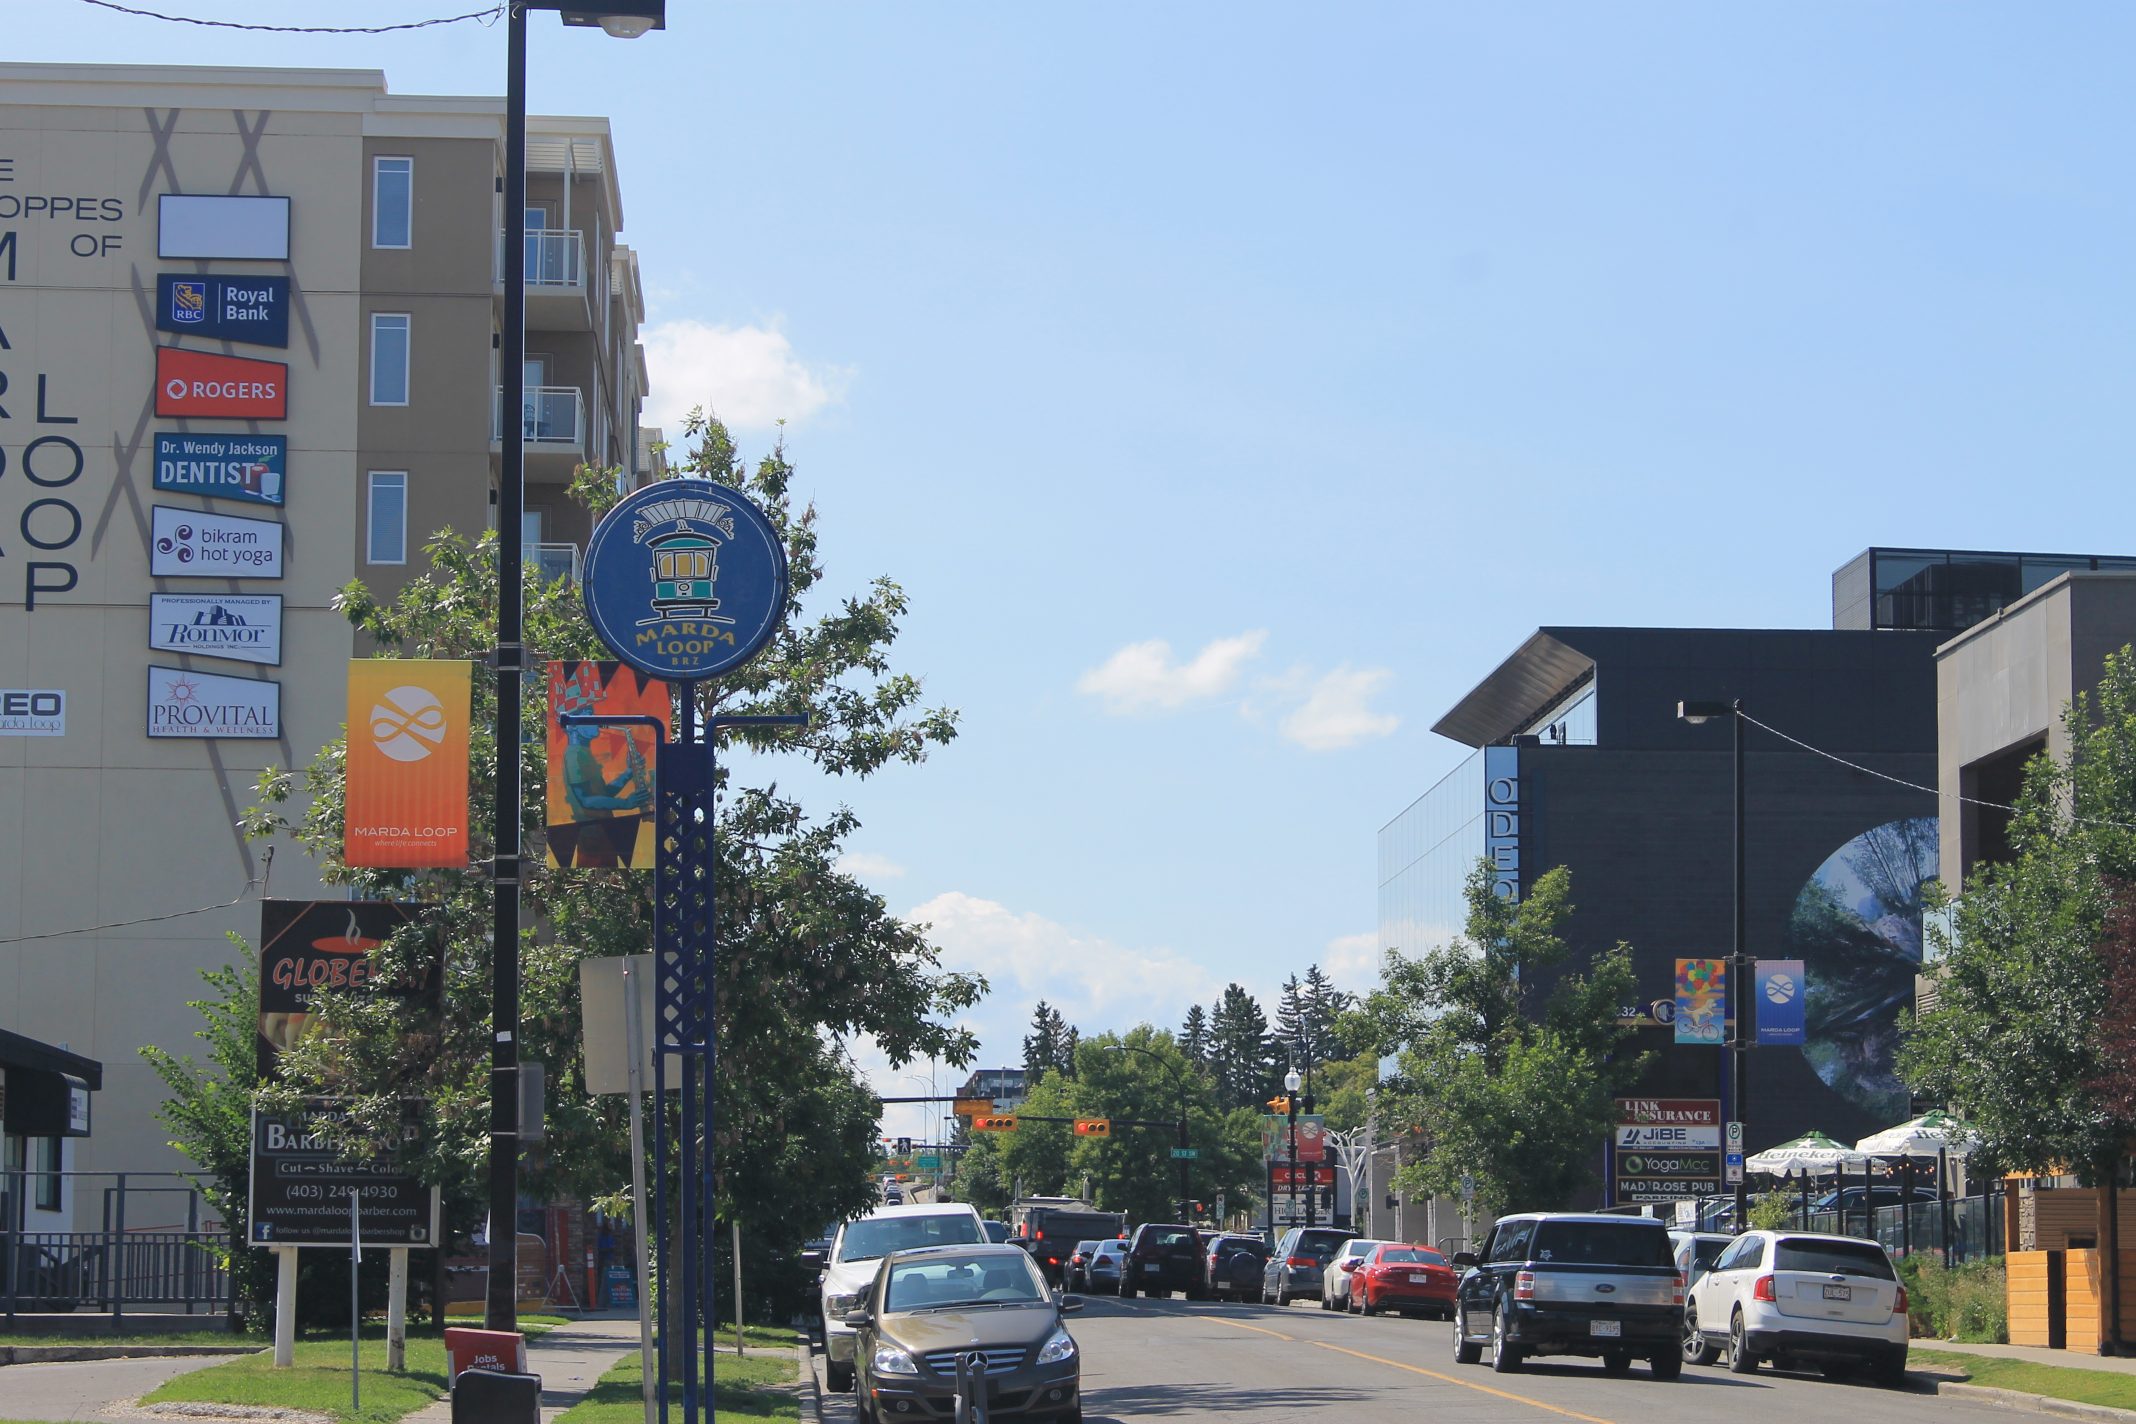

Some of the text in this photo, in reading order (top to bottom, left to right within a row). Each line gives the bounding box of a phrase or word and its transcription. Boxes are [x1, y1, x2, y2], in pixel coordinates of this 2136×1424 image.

[71, 234, 122, 257] OF
[226, 286, 274, 304] Royal
[176, 310, 201, 320] RBC
[226, 305, 269, 321] Bank
[192, 381, 276, 399] ROGERS
[161, 441, 278, 457] Dr. Wendy Jackson
[160, 461, 254, 484] DENTIST
[201, 528, 258, 543] bikram
[201, 547, 273, 566] hot yoga
[635, 622, 736, 647] MARDA
[657, 640, 715, 655] LOOP
[0, 693, 61, 716] EO
[153, 704, 273, 726] PROVITAL
[30, 716, 61, 732] loop
[215, 726, 274, 734] WELLNESS
[354, 827, 458, 837] MARDA LOOP
[1488, 777, 1515, 904] ODEO
[1625, 1101, 1659, 1110] LINK
[1634, 1109, 1711, 1121] INSURANCE
[281, 1163, 403, 1174] Cut Shave Colo
[286, 1185, 323, 1200] (403)
[361, 1185, 398, 1198] 4930
[1621, 1182, 1715, 1192] MAD ROSE PUB
[275, 1226, 299, 1234] follow
[473, 1354, 497, 1364] Jobs
